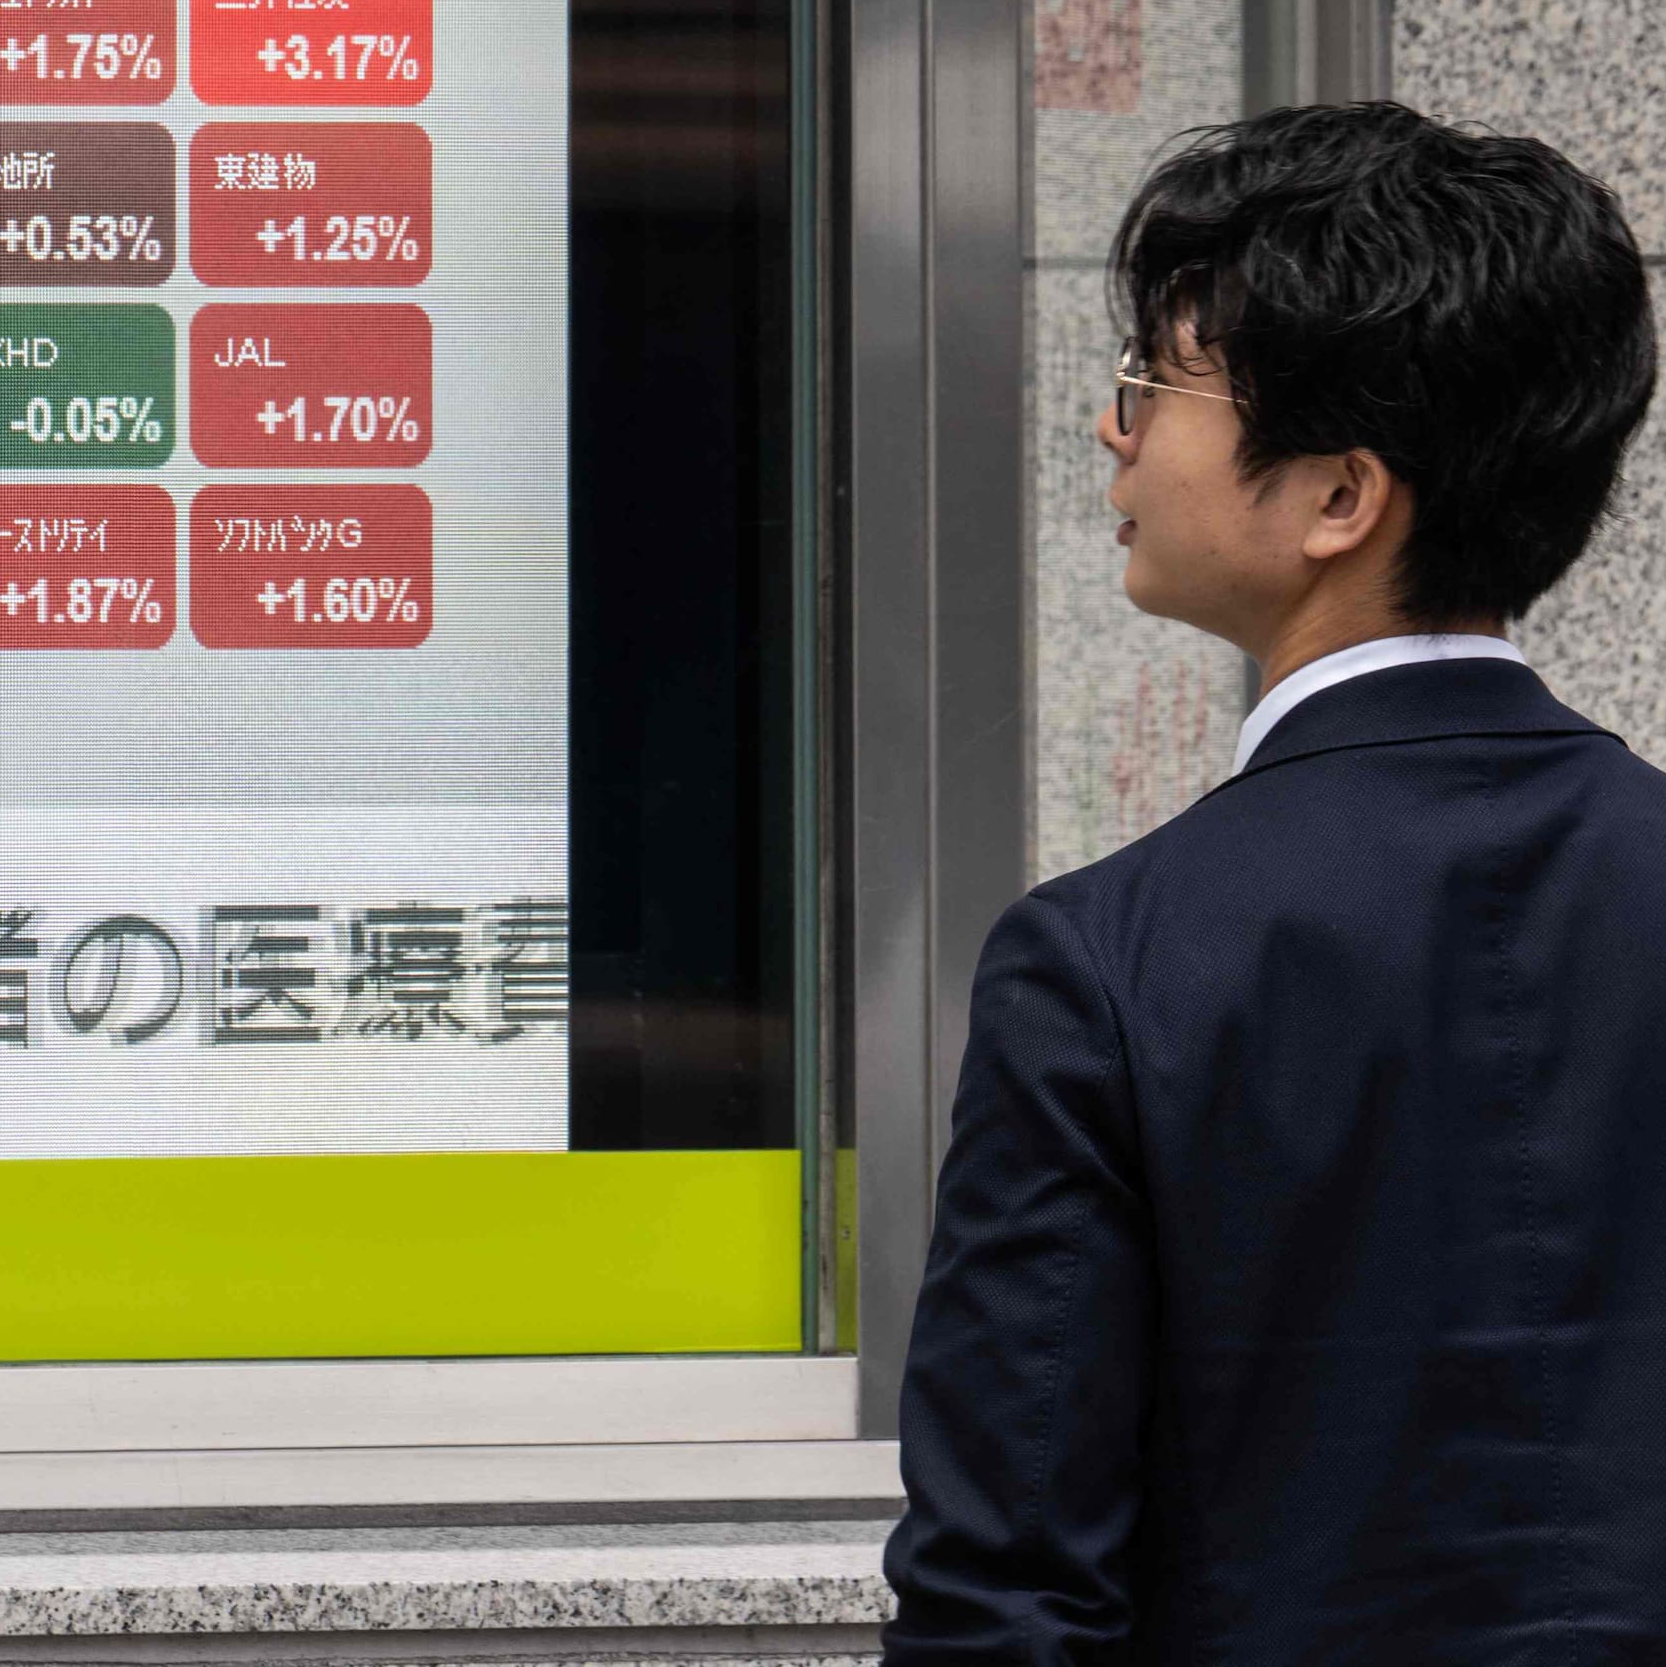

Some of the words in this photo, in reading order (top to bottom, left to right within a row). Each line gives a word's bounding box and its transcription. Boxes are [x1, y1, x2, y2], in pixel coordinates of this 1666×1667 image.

[257, 33, 420, 81] +3.17%
[256, 214, 419, 262] +1.25%
[212, 336, 286, 368] JAL
[9, 395, 163, 444] -0.05%
[256, 394, 420, 443] +1.70%
[256, 576, 420, 624] +1.60%
